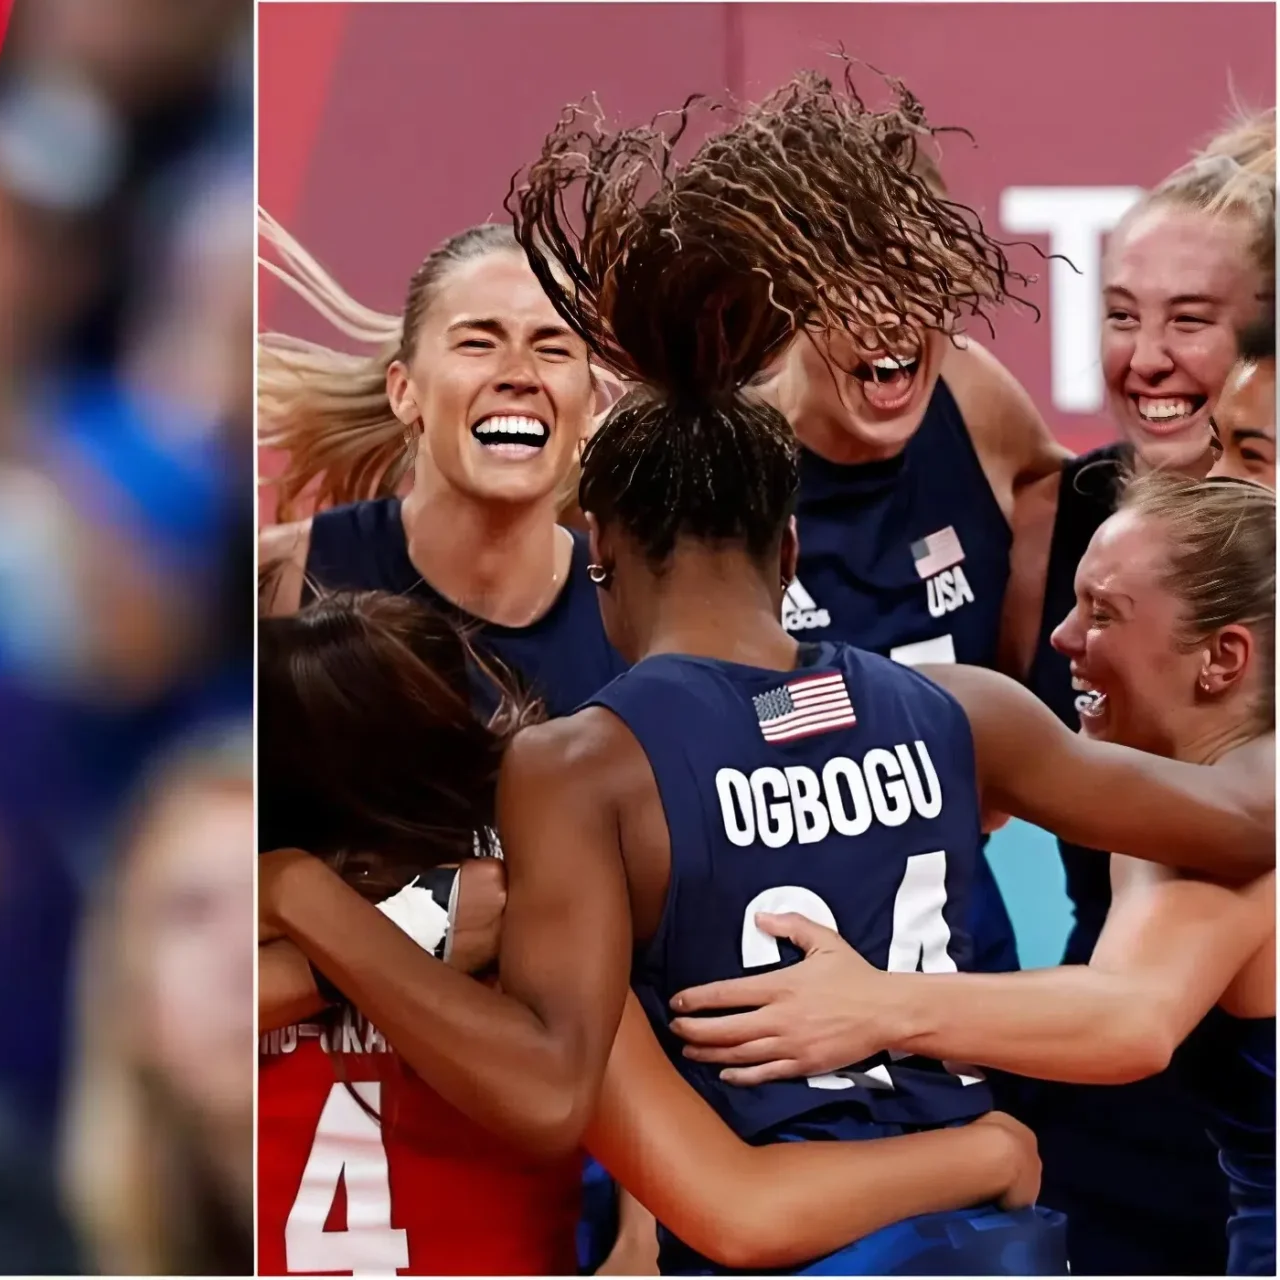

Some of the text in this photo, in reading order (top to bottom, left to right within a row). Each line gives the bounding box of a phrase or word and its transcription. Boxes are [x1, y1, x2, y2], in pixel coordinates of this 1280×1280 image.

[926, 566, 975, 618] USA
[716, 740, 943, 848] OGBOGU
[285, 1082, 409, 1275] 4
